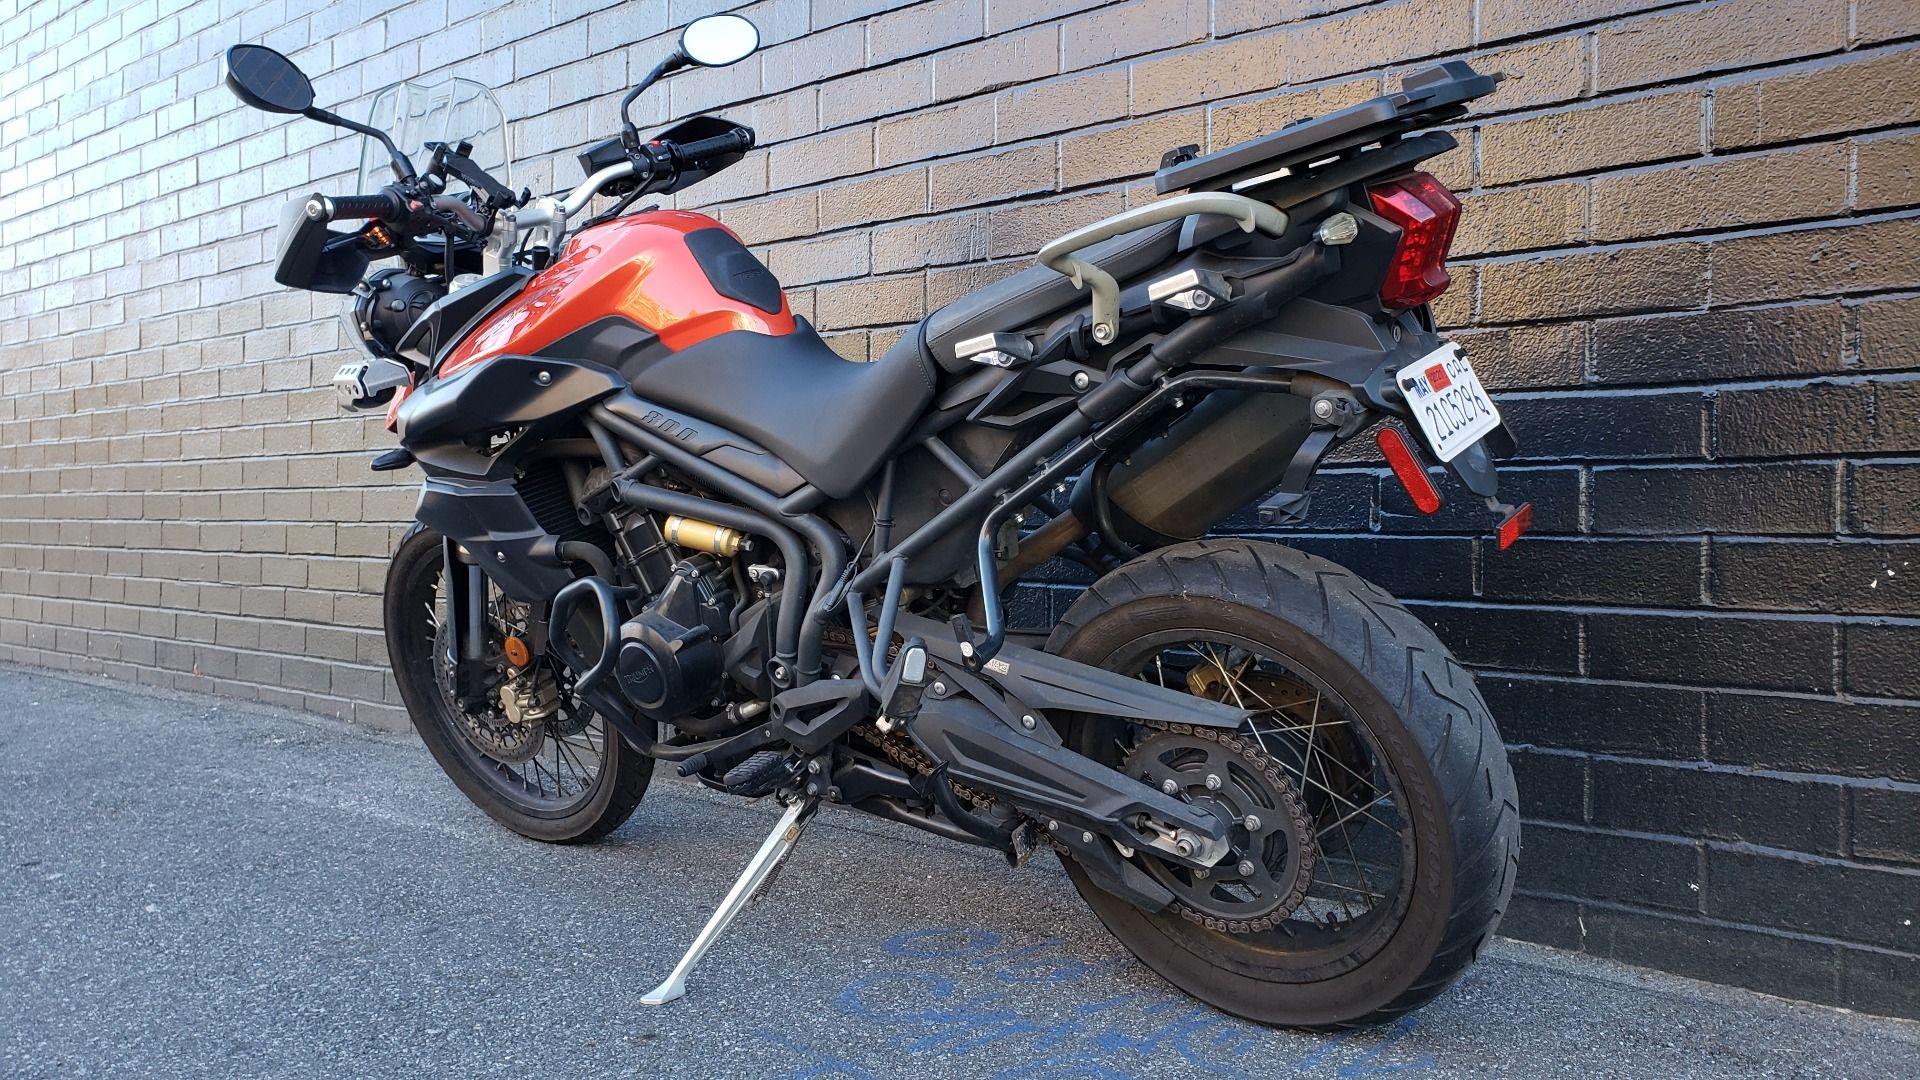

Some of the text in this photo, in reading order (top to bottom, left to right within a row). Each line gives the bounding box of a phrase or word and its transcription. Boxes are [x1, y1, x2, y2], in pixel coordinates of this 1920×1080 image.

[1446, 359, 1468, 379] CAL
[1414, 375, 1432, 398] MAY
[1425, 381, 1486, 441] 21C5296
[641, 410, 699, 441] 800
[624, 664, 654, 684] TRIUMPH
